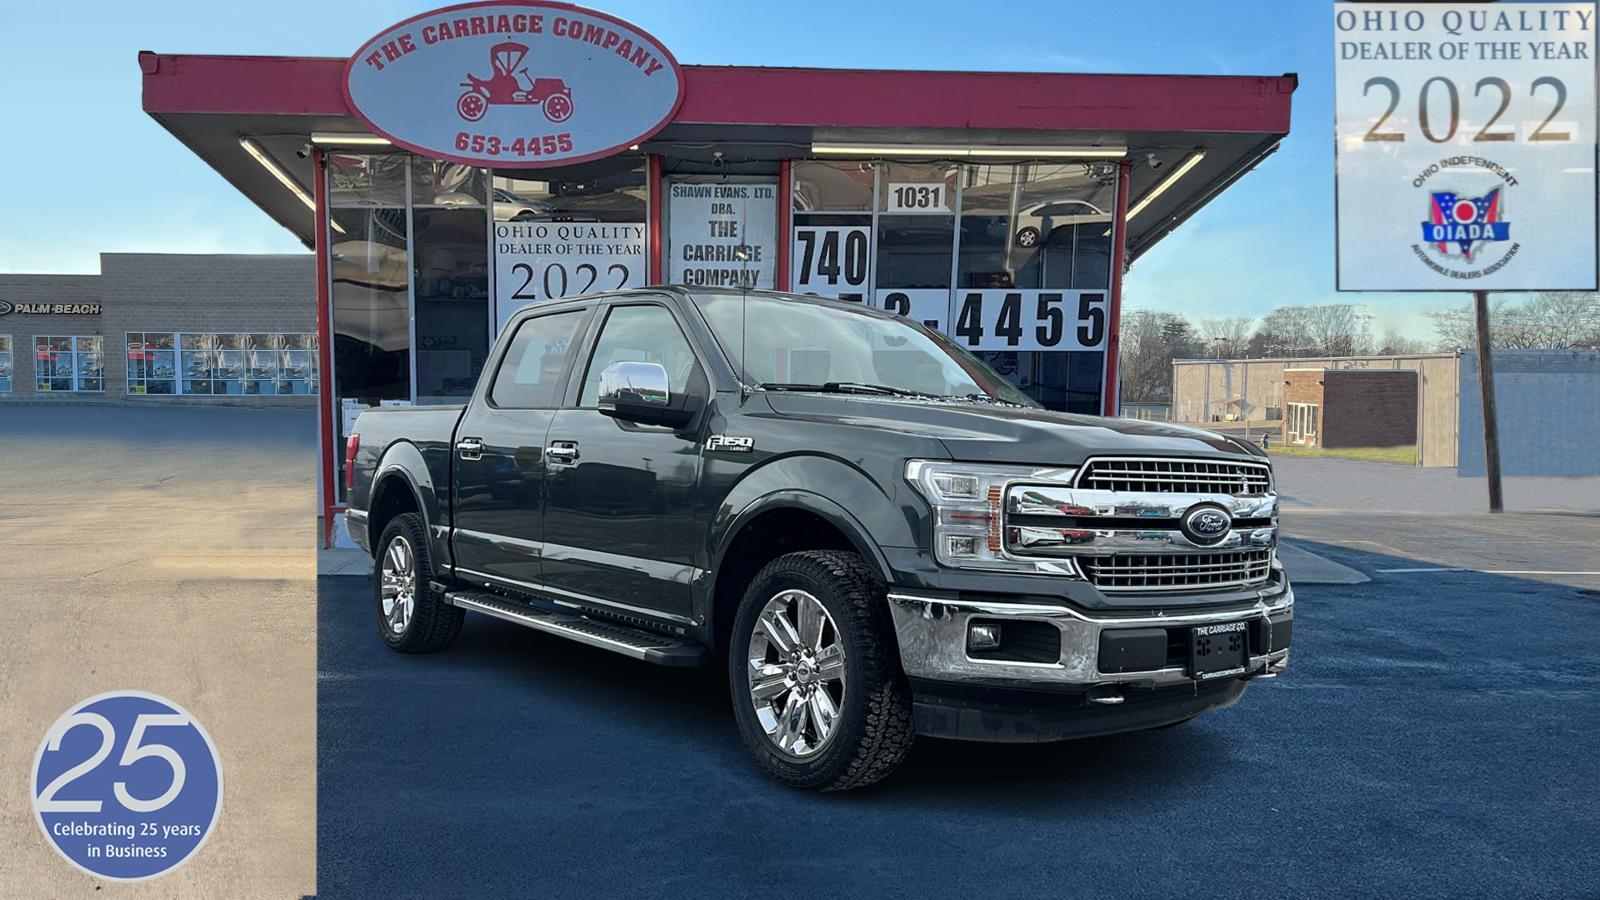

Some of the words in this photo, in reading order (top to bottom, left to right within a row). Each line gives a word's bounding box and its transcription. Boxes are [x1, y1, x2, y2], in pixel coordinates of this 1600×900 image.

[1336, 10, 1425, 32] OHIO
[1442, 10, 1592, 35] QUALITY
[365, 32, 417, 72] THE
[422, 14, 543, 45] CARRIAGE
[552, 16, 664, 77] COMPANY
[1341, 42, 1433, 60] DEALER
[1438, 42, 1469, 60] OF
[1475, 42, 1522, 60] THE
[1528, 42, 1589, 60] YEAR
[1363, 76, 1571, 143] 2022
[454, 131, 573, 157] 653-4455
[1412, 163, 1440, 188] OHIO
[1439, 155, 1519, 187] INDEPENDENT
[672, 186, 712, 199] SHAWN
[754, 187, 774, 199] LTD.
[894, 186, 941, 208] 1031
[711, 203, 735, 215] DBA.
[497, 225, 551, 239] OHIO
[558, 225, 644, 241] QUALITY
[708, 220, 737, 237] THE
[1432, 223, 1495, 241] OIADA
[499, 243, 552, 255] DEALER
[555, 243, 573, 255] OF
[576, 243, 603, 256] THE
[607, 244, 641, 255] YEAR
[683, 243, 762, 262] CARRIAGE
[797, 230, 868, 286] 740
[683, 268, 760, 286] COMPANY
[14, 303, 51, 315] PALM
[54, 303, 100, 315] BEACH
[1200, 514, 1224, 532] Ford
[1197, 627, 1209, 635] THE
[1209, 623, 1236, 634] CARRIAGE
